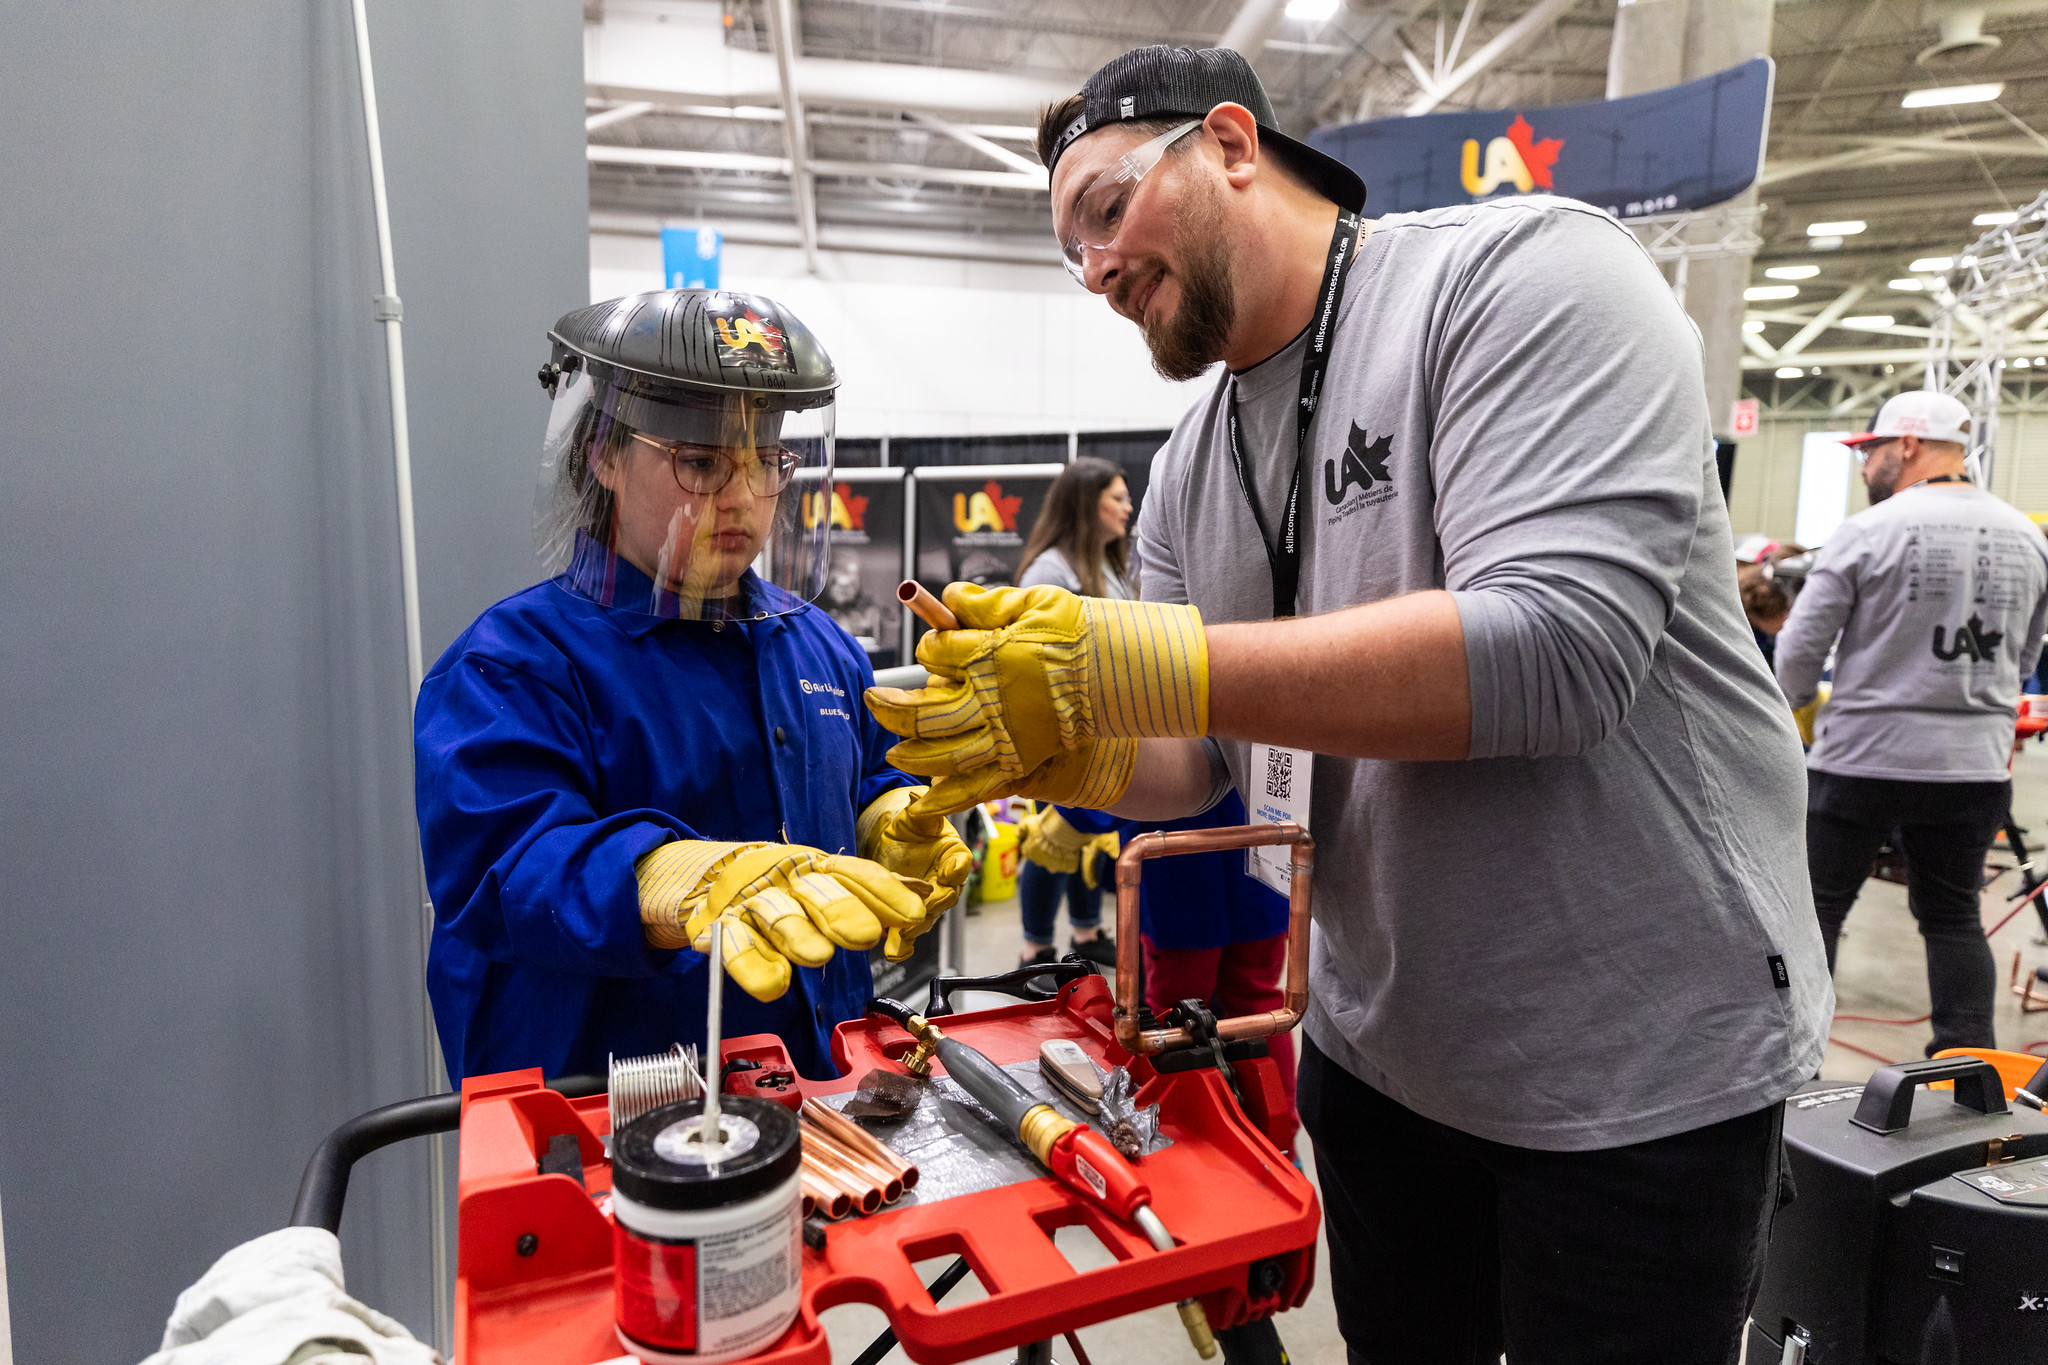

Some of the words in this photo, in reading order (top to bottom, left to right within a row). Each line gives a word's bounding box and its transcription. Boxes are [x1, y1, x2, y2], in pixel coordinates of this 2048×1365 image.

[1461, 137, 1534, 195] UA
[1315, 238, 1349, 353] skillscompetencescanada.com
[716, 317, 773, 353] UA
[1325, 447, 1374, 505] UA
[1358, 488, 1383, 501] Métiers
[1384, 484, 1394, 492] de
[803, 490, 852, 530] UA
[953, 491, 1004, 532] UA
[1932, 622, 1982, 662] UA
